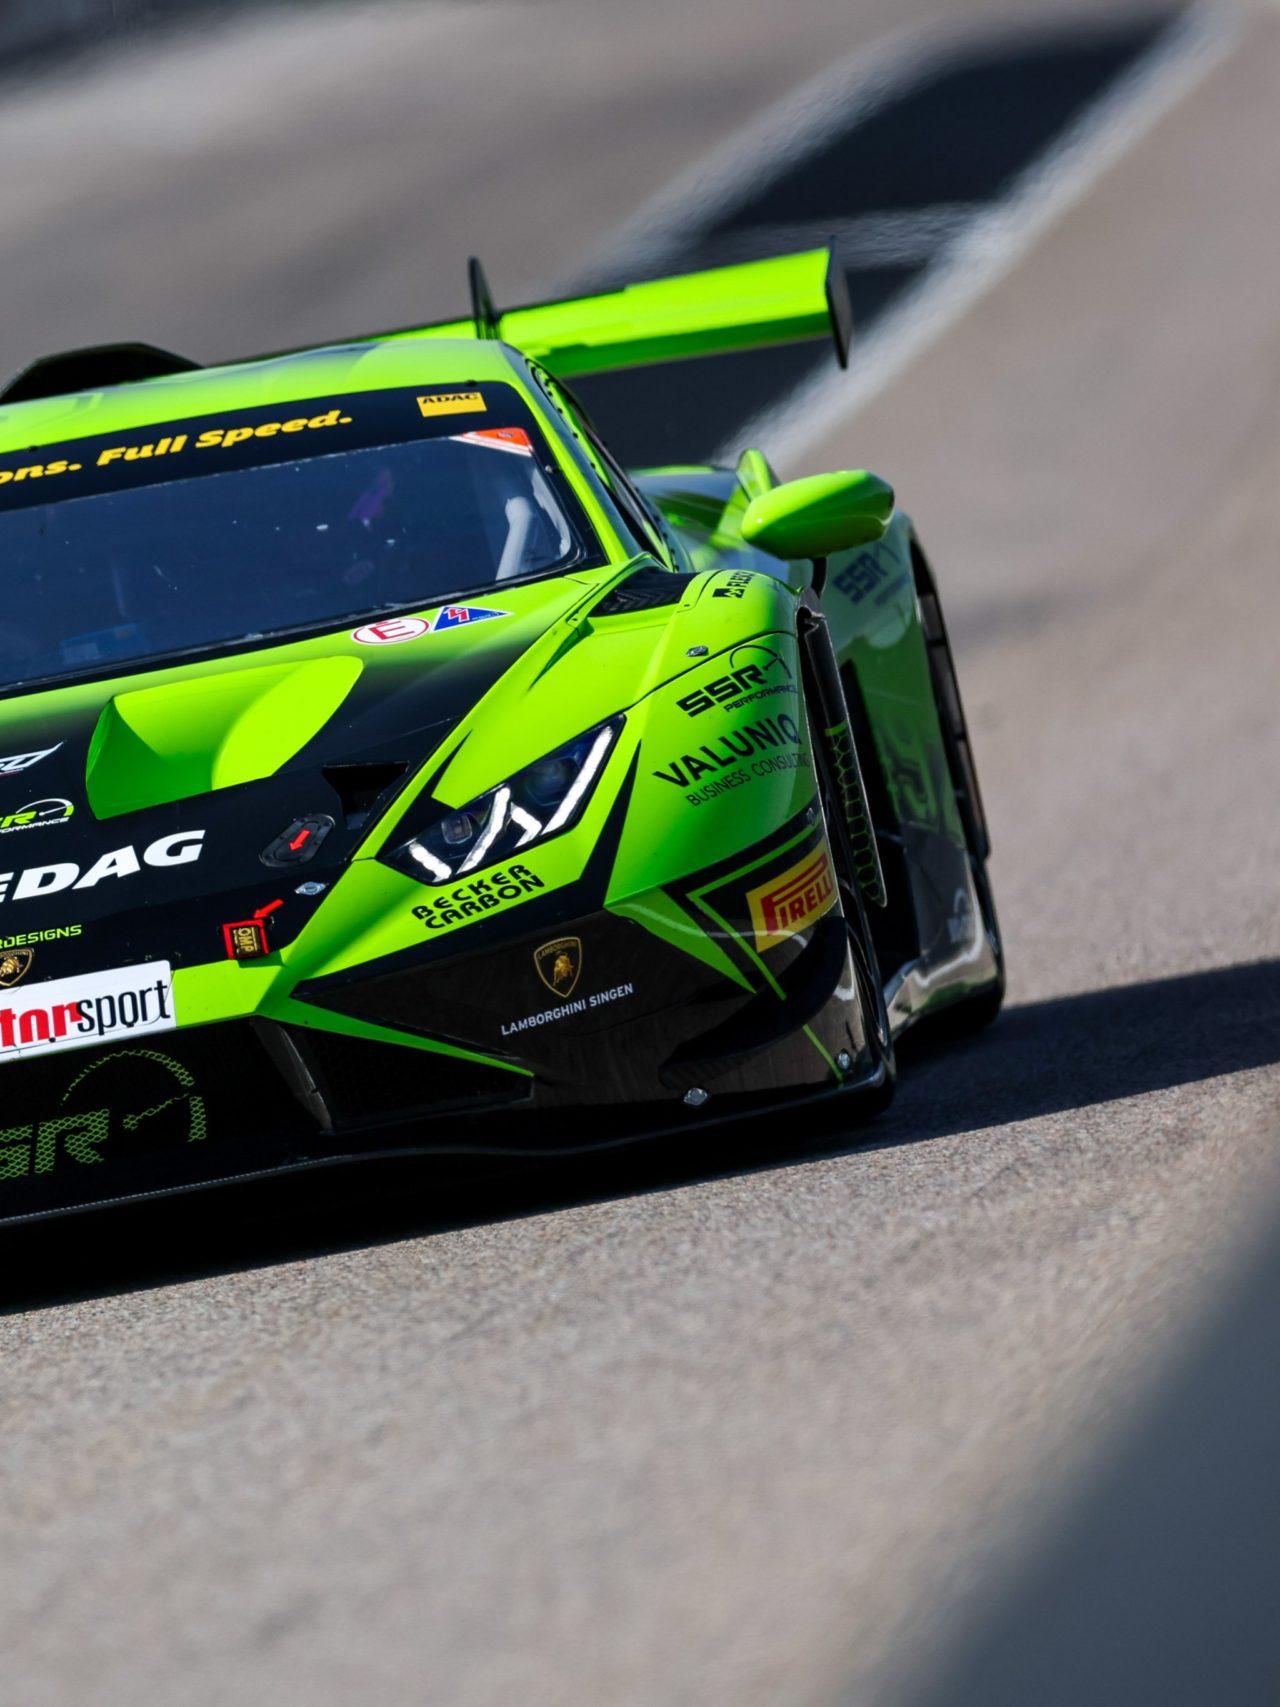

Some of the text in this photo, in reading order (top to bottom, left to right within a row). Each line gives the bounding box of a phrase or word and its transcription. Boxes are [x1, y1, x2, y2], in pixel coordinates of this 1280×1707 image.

[96, 435, 187, 466] Full
[195, 409, 353, 449] Speed.
[368, 619, 415, 641] E
[676, 664, 767, 717] SSR
[651, 714, 802, 788] VALUNIQ
[685, 769, 752, 807] BUSINESS
[411, 864, 532, 920] BECKER
[425, 874, 545, 929] CARBON
[501, 983, 633, 1036] LAMBORGHINI SINGEN
